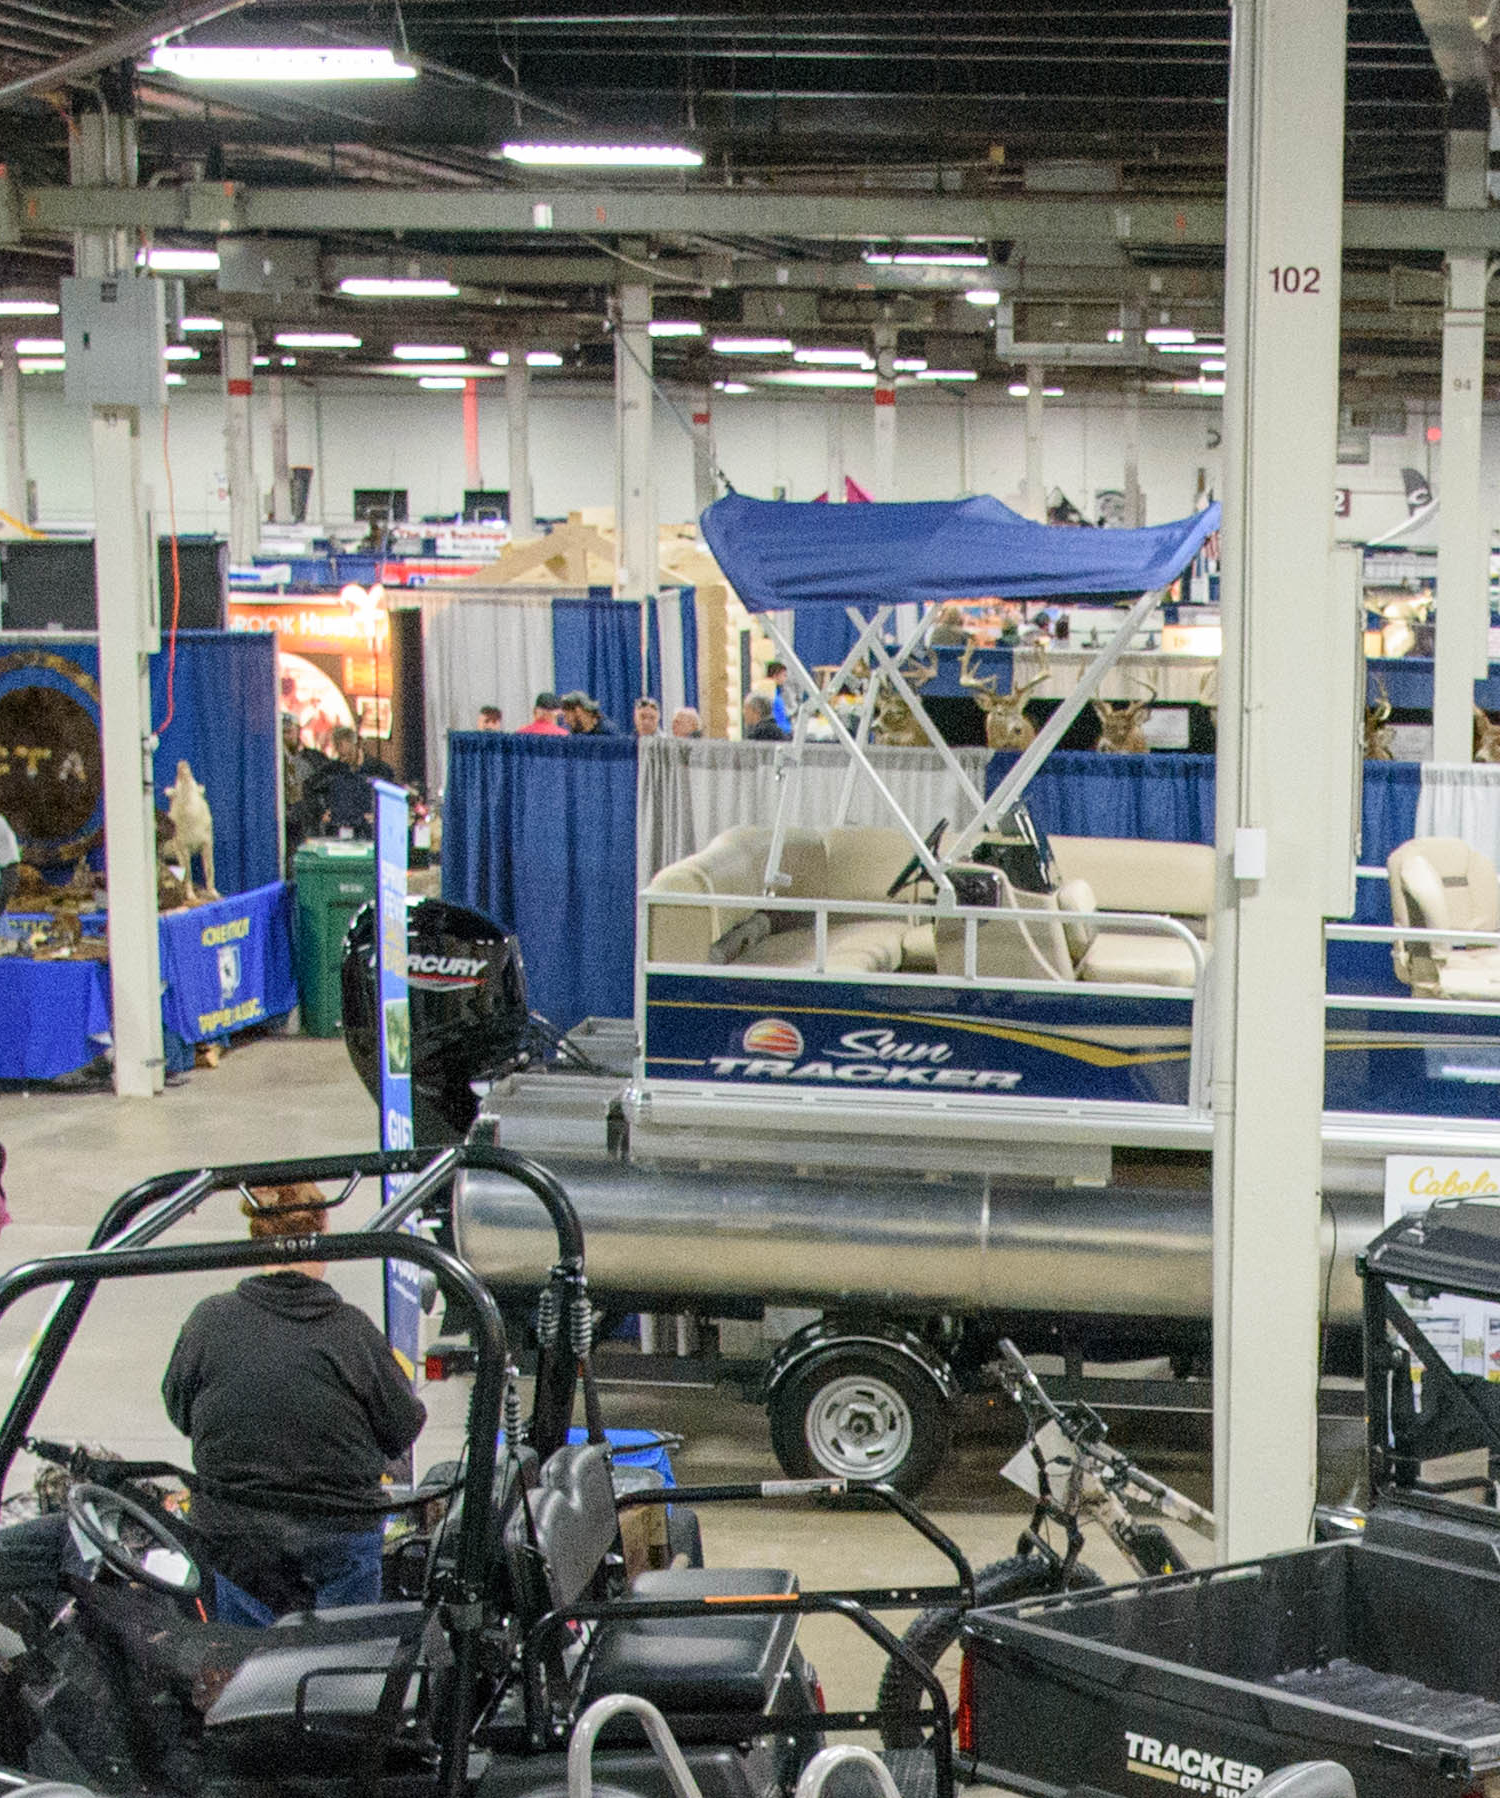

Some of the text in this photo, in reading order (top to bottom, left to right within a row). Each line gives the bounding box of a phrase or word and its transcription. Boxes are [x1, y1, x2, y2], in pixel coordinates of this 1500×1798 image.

[1269, 266, 1321, 294] 102
[1453, 378, 1472, 392] 94
[823, 1028, 953, 1063] Sun
[709, 1056, 1023, 1090] TRACKER
[1125, 1731, 1264, 1791] TRACKER
[1180, 1774, 1212, 1794] OFF
